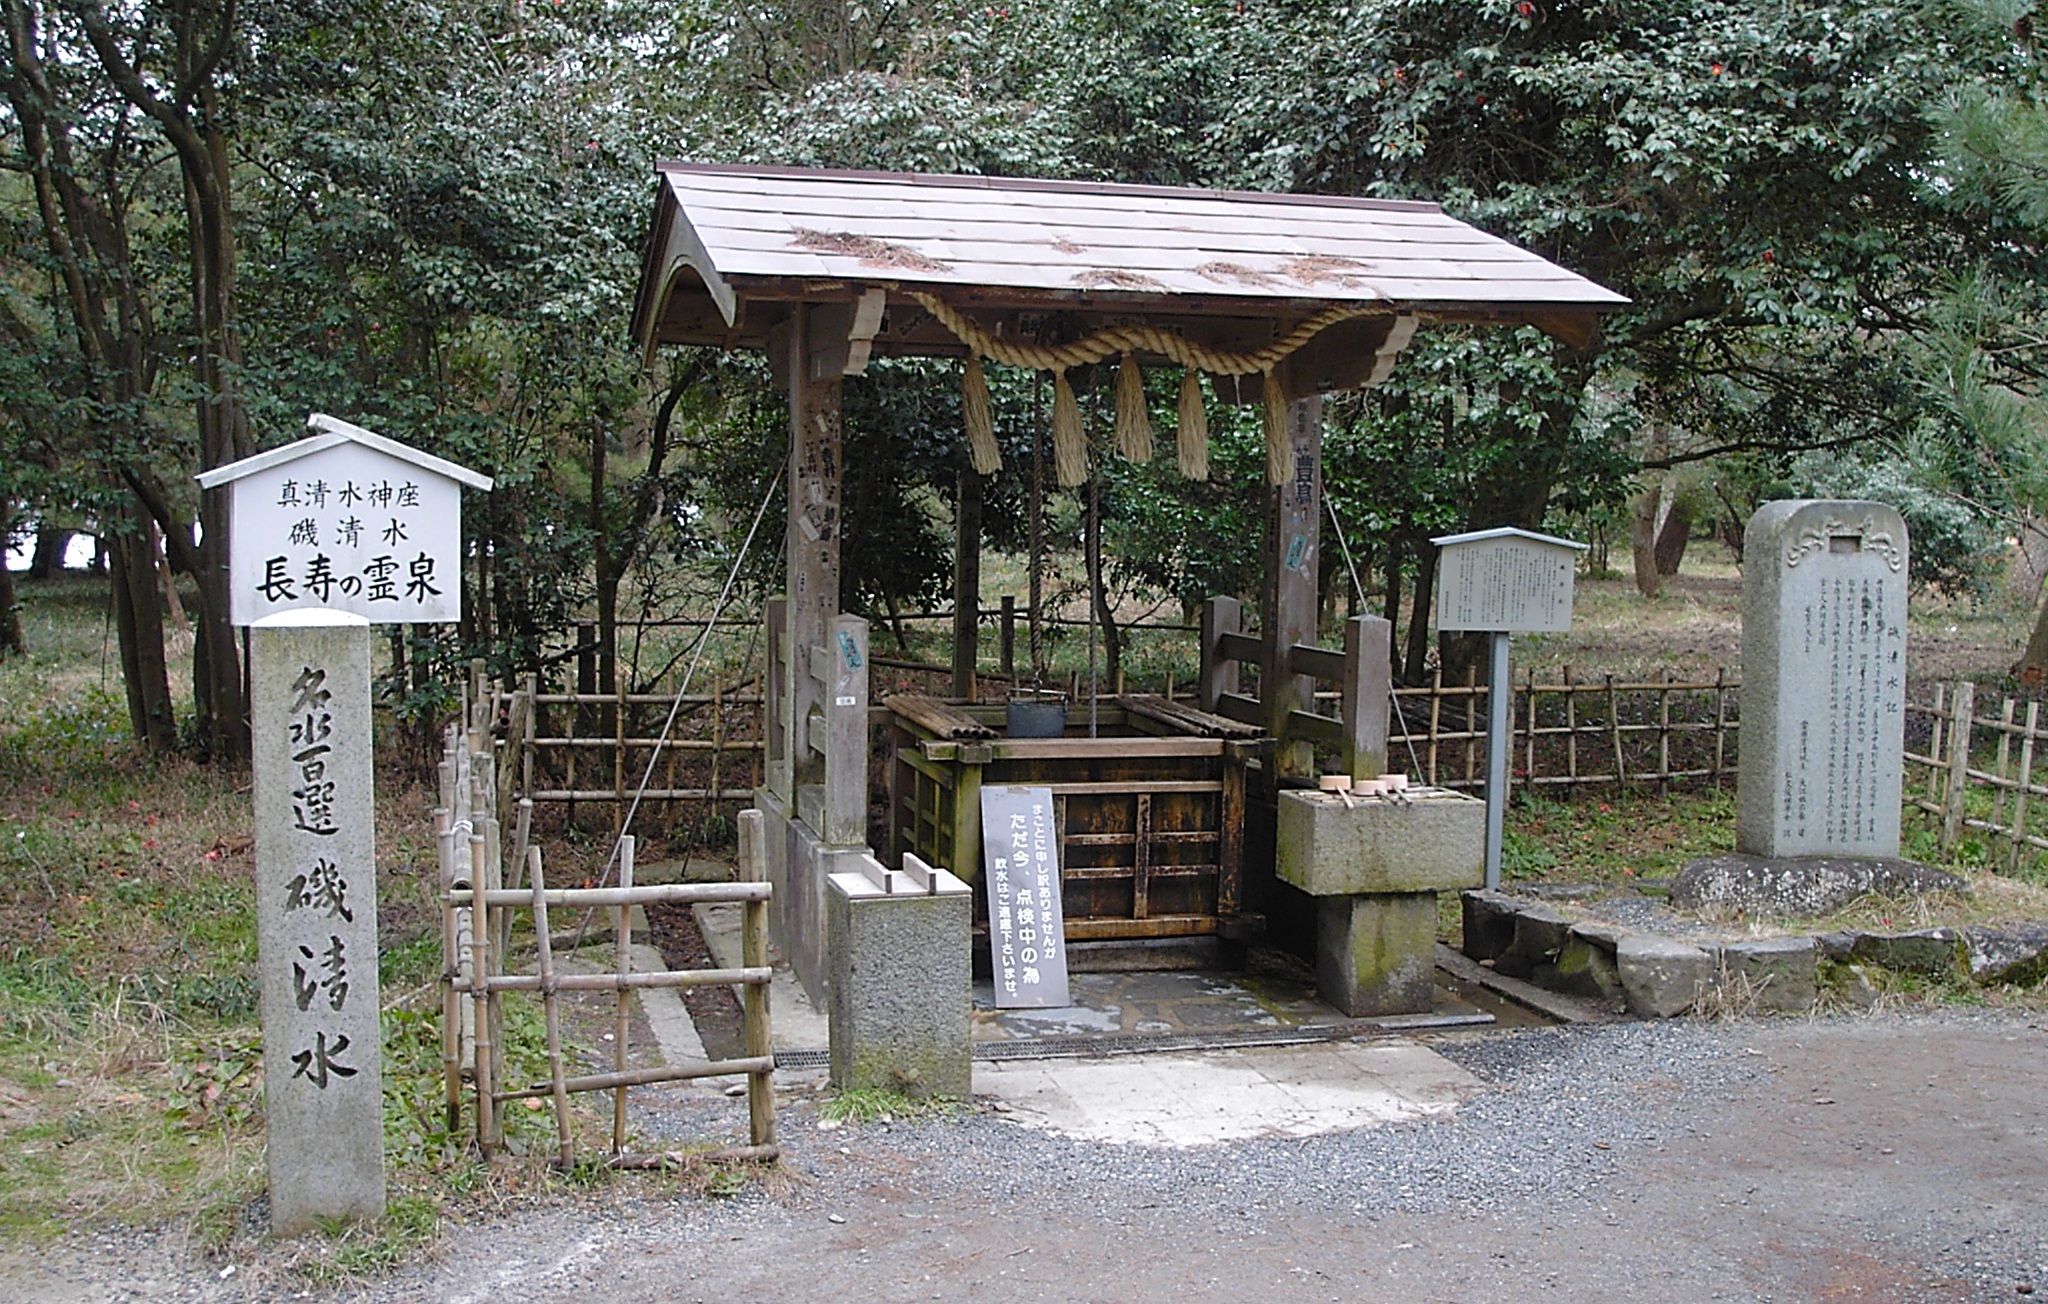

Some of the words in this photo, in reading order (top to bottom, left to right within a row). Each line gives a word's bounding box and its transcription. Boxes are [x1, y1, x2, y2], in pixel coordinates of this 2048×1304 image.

[277, 478, 420, 509] 真清水神座
[287, 515, 410, 549] 磯清水
[255, 552, 443, 604] 長寿の霊泉
[1010, 813, 1041, 985] ただ今、点検中の為
[1032, 804, 1057, 960] まことに申し訳ありませんが
[284, 857, 358, 1090] 磯清水
